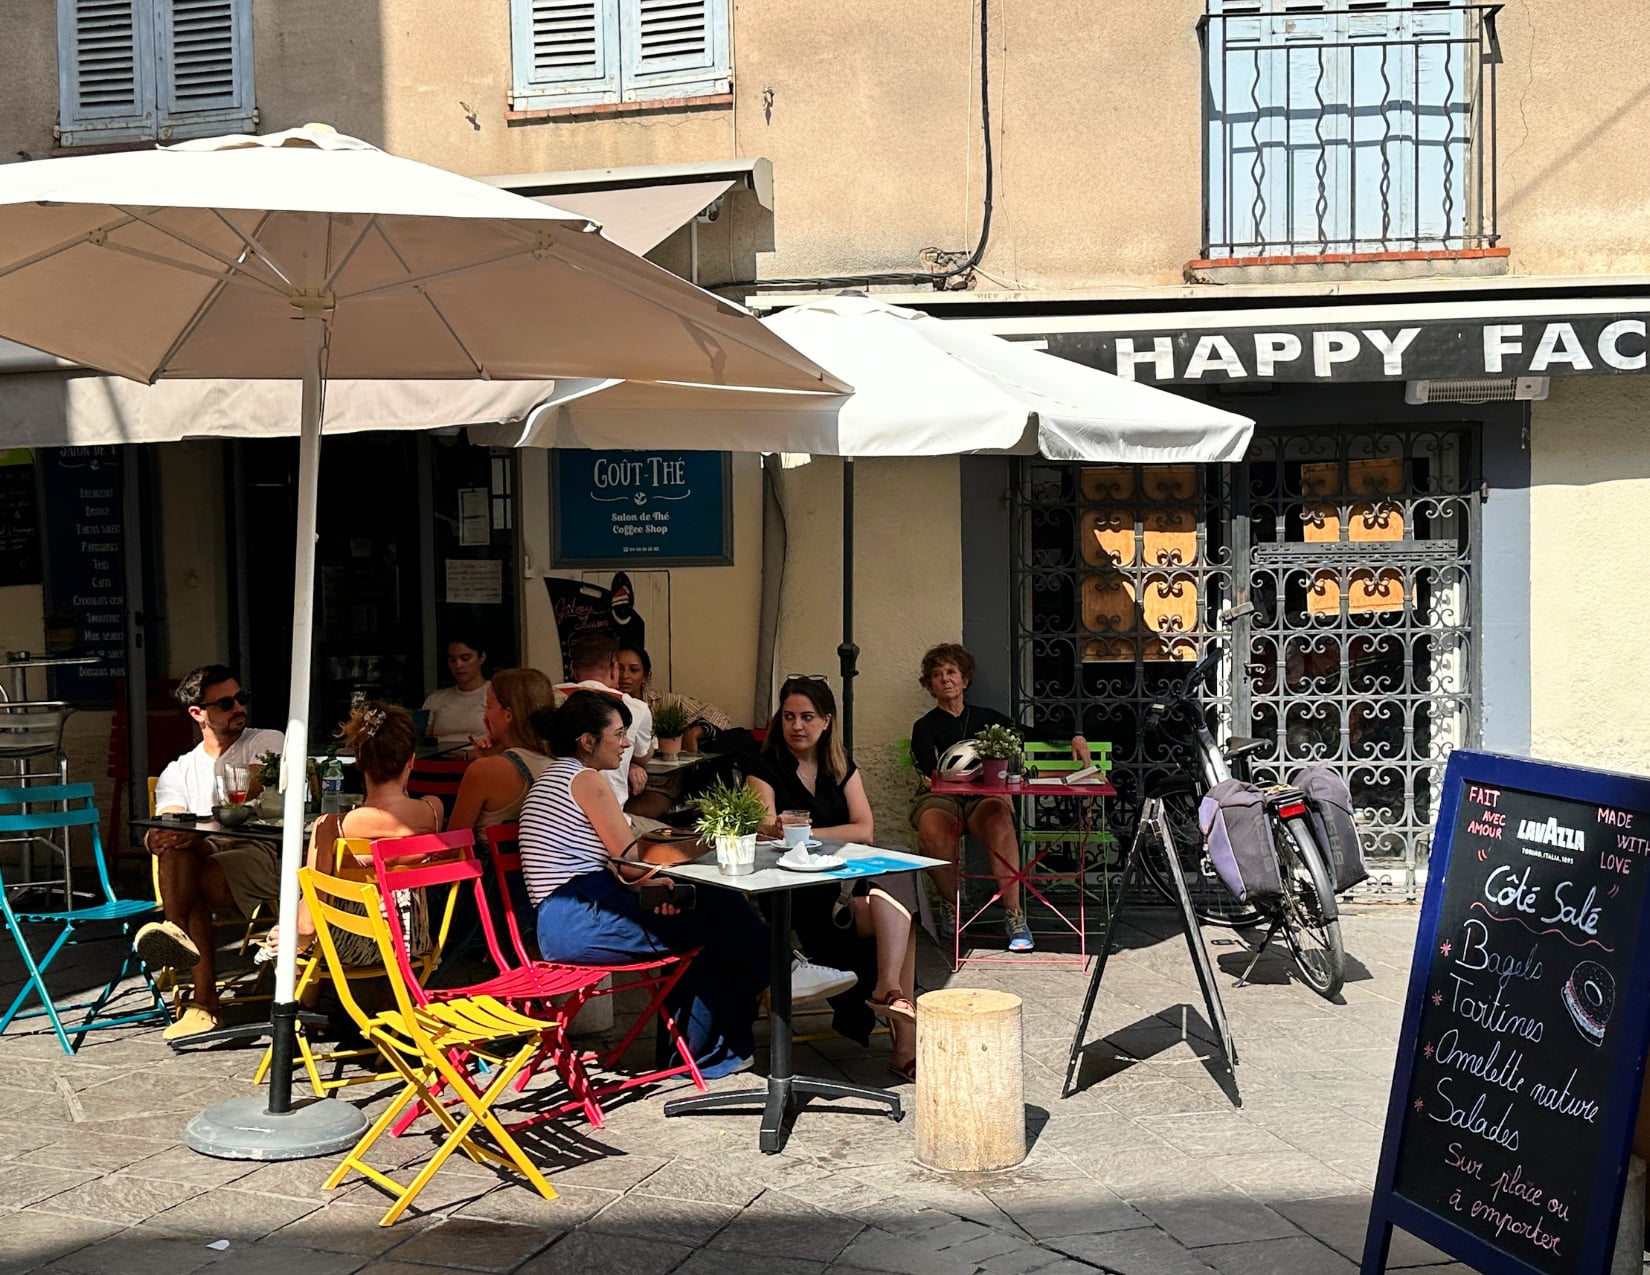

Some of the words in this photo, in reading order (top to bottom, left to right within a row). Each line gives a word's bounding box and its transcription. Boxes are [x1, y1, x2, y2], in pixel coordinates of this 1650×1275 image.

[1115, 328, 1422, 381] HAPPY
[1482, 319, 1647, 374] FAC
[593, 456, 686, 488] GOÛT-THÉ
[611, 512, 638, 522] Salon
[639, 511, 651, 521] de
[652, 511, 671, 521] Thé
[612, 524, 644, 536] Coffee
[645, 524, 668, 535] Shop
[1469, 786, 1501, 808] FAIT
[1467, 820, 1503, 840] AMOUR
[1482, 810, 1507, 827] AVEC
[1516, 816, 1585, 852] LAVAZZA
[1597, 807, 1634, 829] MADE
[1600, 851, 1632, 875] LOVE
[1616, 834, 1650, 858] WITH
[1485, 865, 1541, 914] Côté
[1541, 881, 1602, 936] Salé
[1455, 919, 1544, 988] Bagels
[1449, 972, 1544, 1043] Tartines
[1435, 1028, 1525, 1093] Omelette
[1530, 1068, 1600, 1124] nature
[1428, 1077, 1520, 1151] Salades
[1444, 1142, 1484, 1181] Sur
[1490, 1164, 1544, 1206] place
[1547, 1198, 1570, 1222] ou
[1470, 1199, 1562, 1257] emporter
